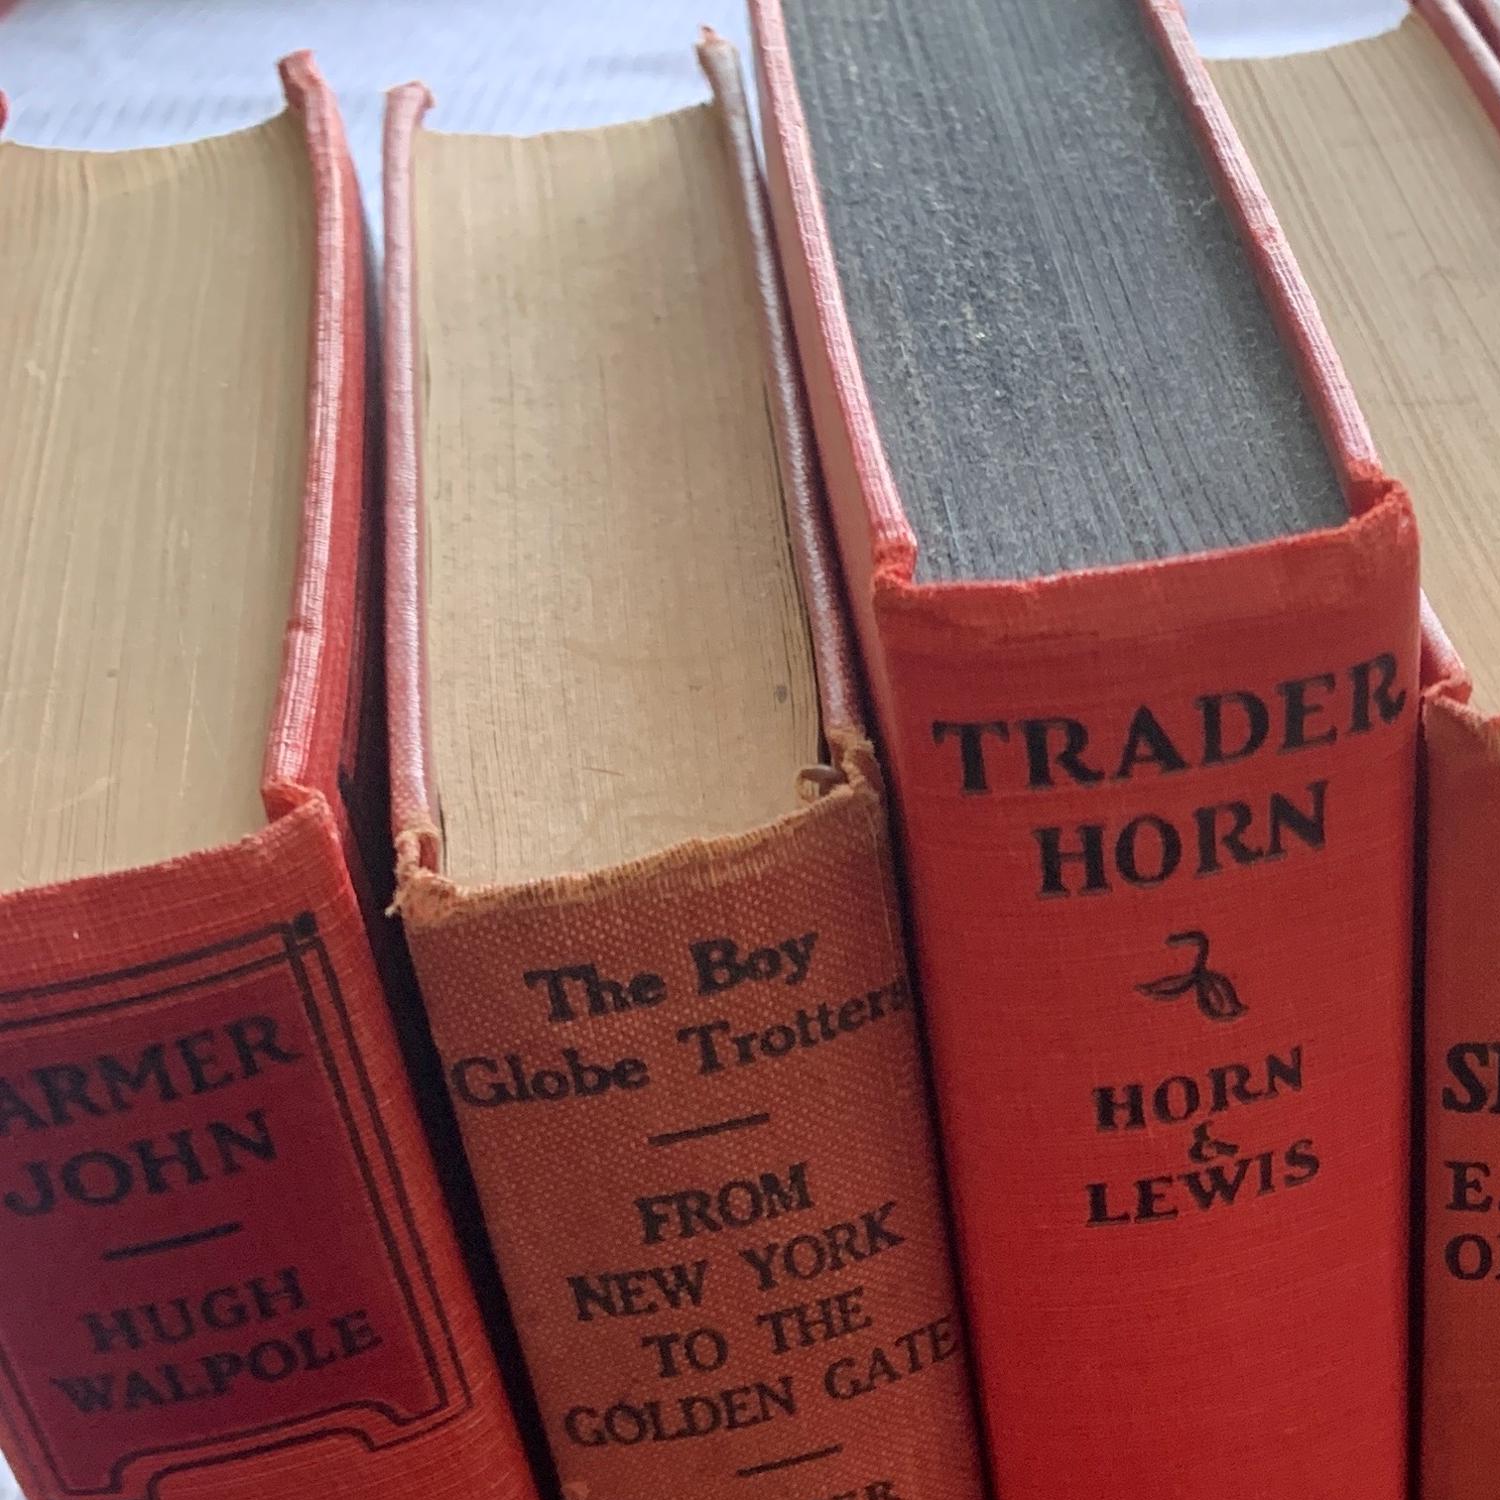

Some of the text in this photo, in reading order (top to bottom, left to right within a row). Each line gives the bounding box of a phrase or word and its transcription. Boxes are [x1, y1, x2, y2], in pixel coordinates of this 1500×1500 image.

[932, 651, 1409, 796] TRADER
[1034, 779, 1330, 900] HORN
[524, 932, 819, 1022] The Boy
[0, 1014, 304, 1135] ARMER
[450, 1048, 649, 1108] Globe
[1091, 1045, 1305, 1132] HORN
[3, 1109, 277, 1215] JOHN
[1085, 1137, 1322, 1228] LEWIS
[1188, 1118, 1239, 1165] &
[634, 1162, 817, 1244] FROM
[568, 1202, 905, 1321] NEW YORK
[84, 1267, 310, 1354] HUGH
[642, 1286, 873, 1379] TO THE
[51, 1310, 383, 1413] WALPOLE
[564, 1313, 959, 1447] GOLDEN GATE
